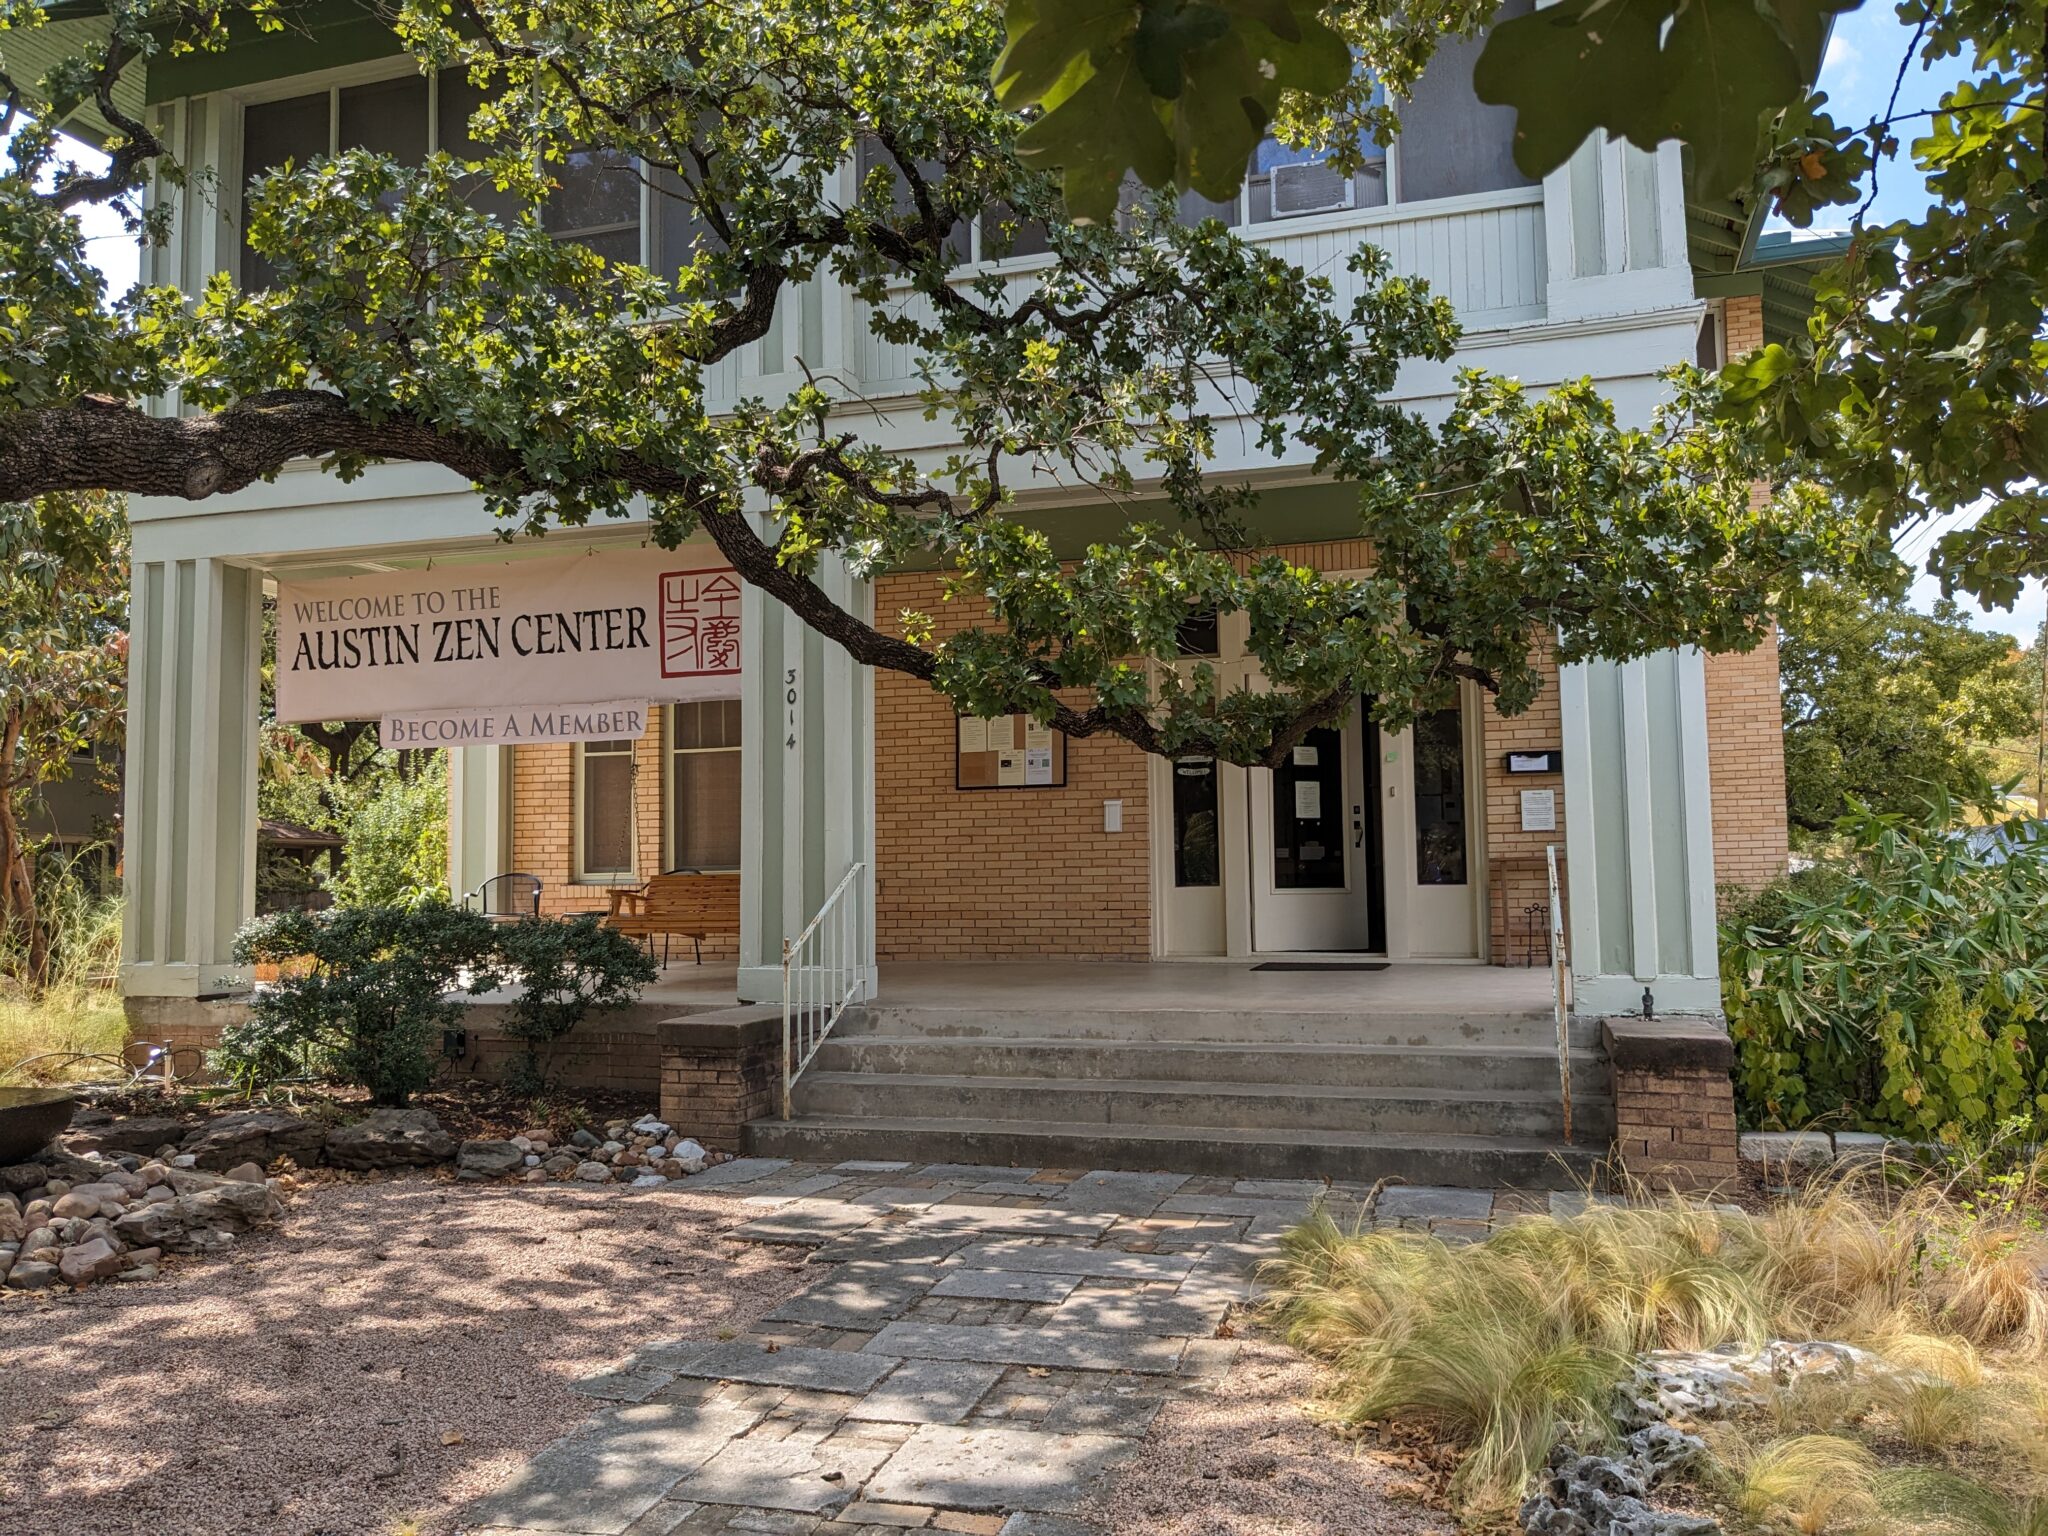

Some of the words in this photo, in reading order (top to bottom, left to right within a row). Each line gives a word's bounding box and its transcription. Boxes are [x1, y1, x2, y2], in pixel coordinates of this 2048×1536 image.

[294, 594, 405, 624] WELCOME
[411, 591, 446, 616] TO
[452, 586, 501, 612] THE
[291, 623, 420, 671] AUSTIN
[432, 616, 501, 663] ZEN
[511, 606, 651, 657] CENTER
[502, 713, 522, 738] A
[784, 668, 798, 750] 3014
